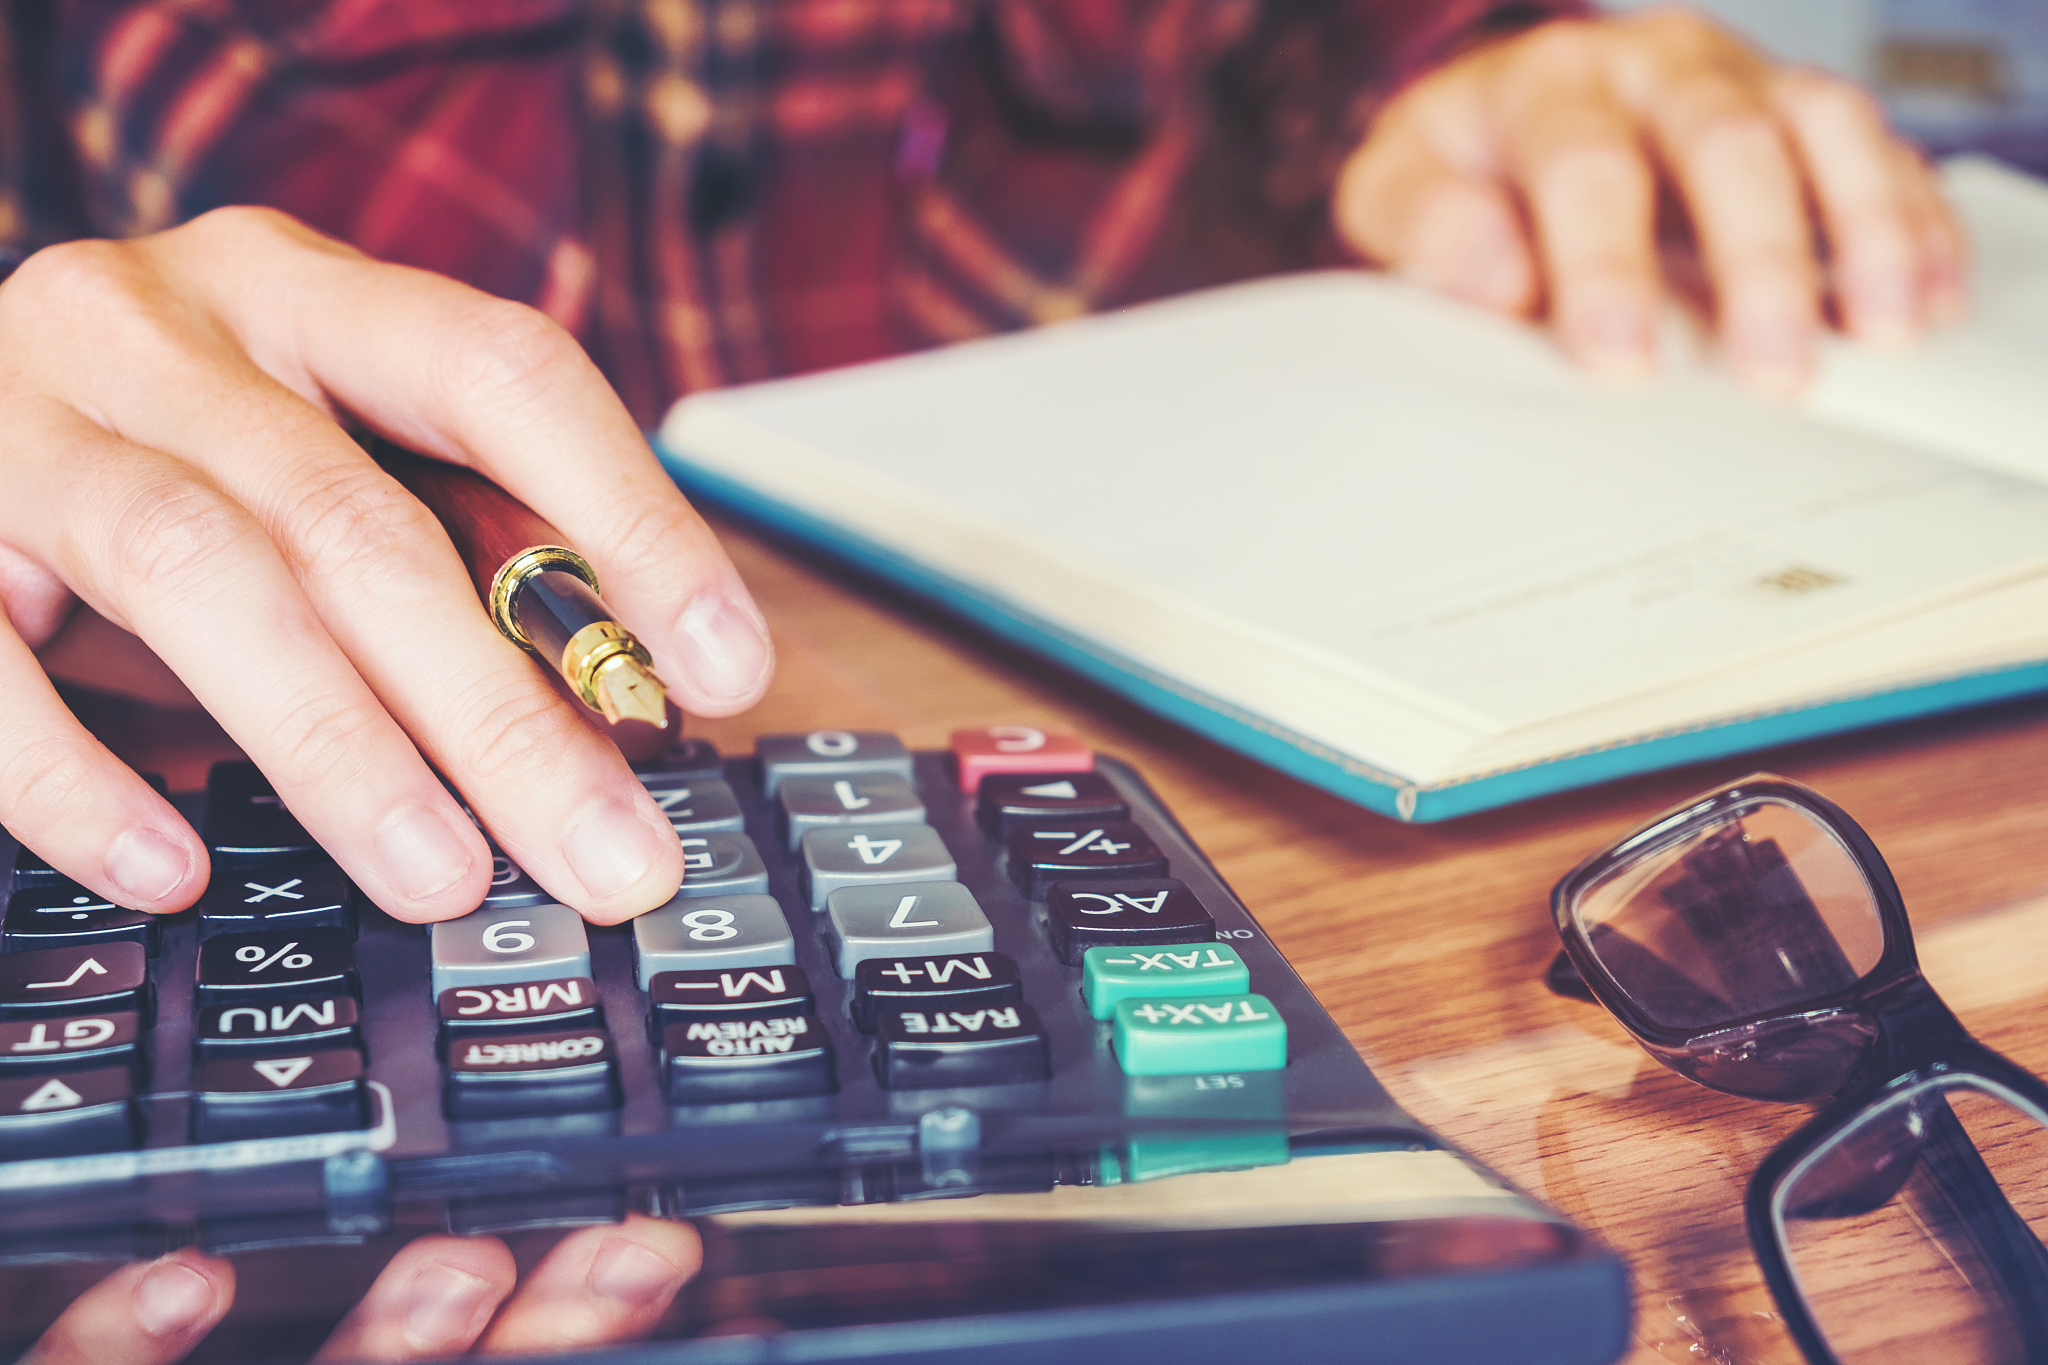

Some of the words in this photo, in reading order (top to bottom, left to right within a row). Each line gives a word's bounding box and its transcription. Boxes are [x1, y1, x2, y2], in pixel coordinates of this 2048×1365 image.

[807, 731, 858, 757] 0
[987, 726, 1046, 751] C
[833, 781, 870, 810] 1
[848, 834, 902, 865] 4
[889, 895, 939, 929] 7
[1072, 890, 1169, 915] AC
[482, 920, 536, 953] 9
[682, 909, 738, 942] 8
[1216, 929, 1255, 940] ON
[881, 956, 992, 984] M+
[1105, 948, 1235, 971] TAX-
[455, 980, 582, 1016] MRC
[218, 1000, 335, 1032] MU
[900, 1007, 1021, 1034] RATE
[1132, 1000, 1270, 1025] TAX+
[11, 1018, 116, 1051] GT
[687, 1016, 808, 1042] REVIEW
[464, 1036, 605, 1065] CORRECT
[707, 1035, 796, 1056] AUTO
[1195, 1074, 1246, 1090] SET
